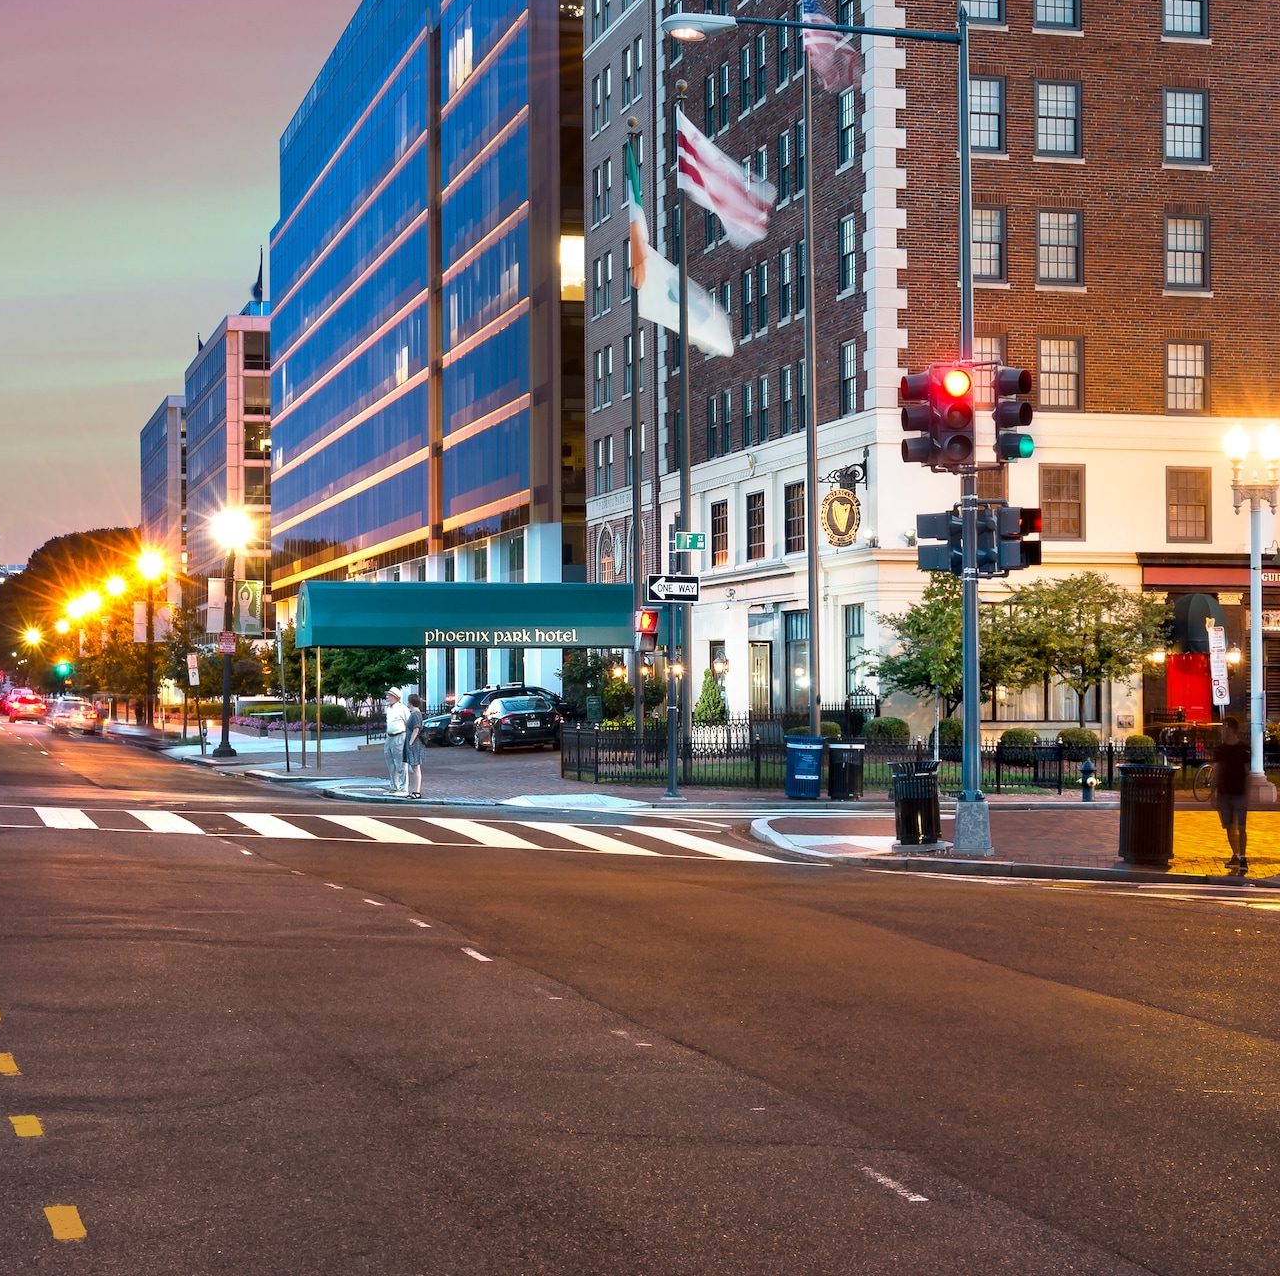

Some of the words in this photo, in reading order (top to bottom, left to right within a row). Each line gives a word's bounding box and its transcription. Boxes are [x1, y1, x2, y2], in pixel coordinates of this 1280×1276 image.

[686, 534, 694, 549] F
[657, 583, 674, 593] ONE
[678, 584, 696, 594] WAY
